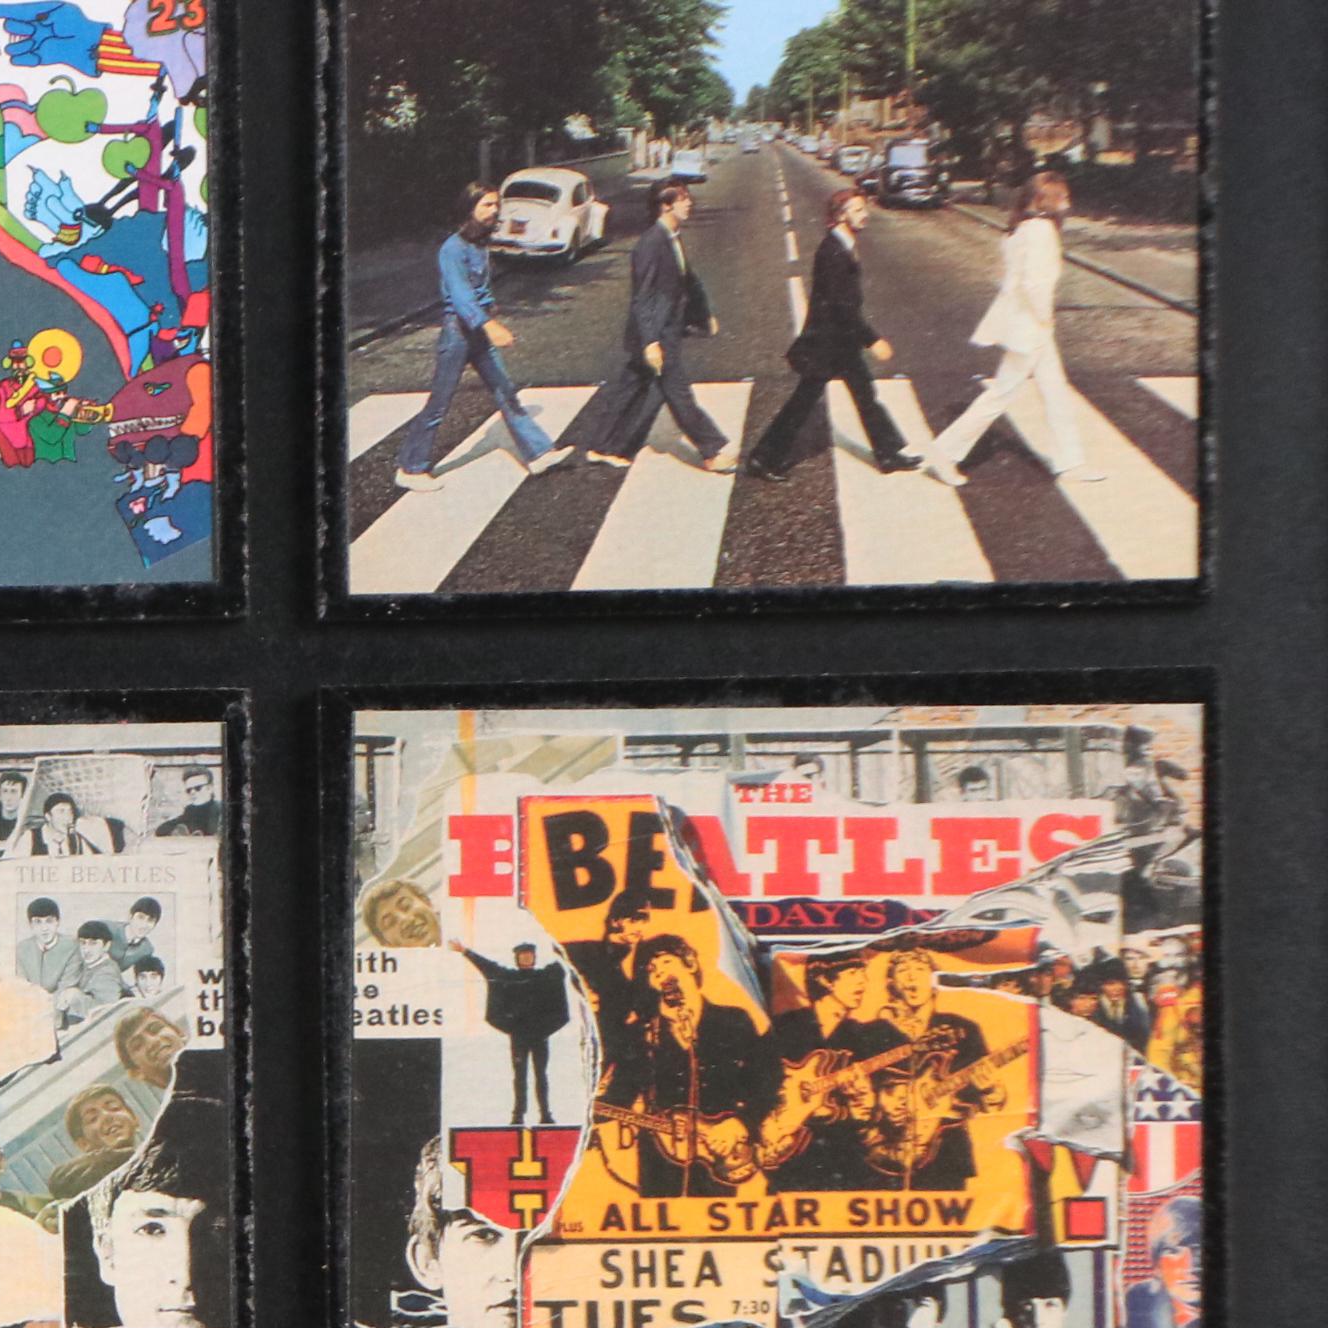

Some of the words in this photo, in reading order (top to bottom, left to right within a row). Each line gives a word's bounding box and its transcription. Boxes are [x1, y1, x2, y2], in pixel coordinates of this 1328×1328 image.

[734, 782, 813, 804] THE
[15, 865, 59, 884] THE
[71, 865, 177, 884] BEATLES
[600, 1201, 681, 1233] ALL
[708, 1198, 822, 1233] STAR
[847, 1197, 974, 1228] SHOW
[599, 1247, 723, 1290] SHEA
